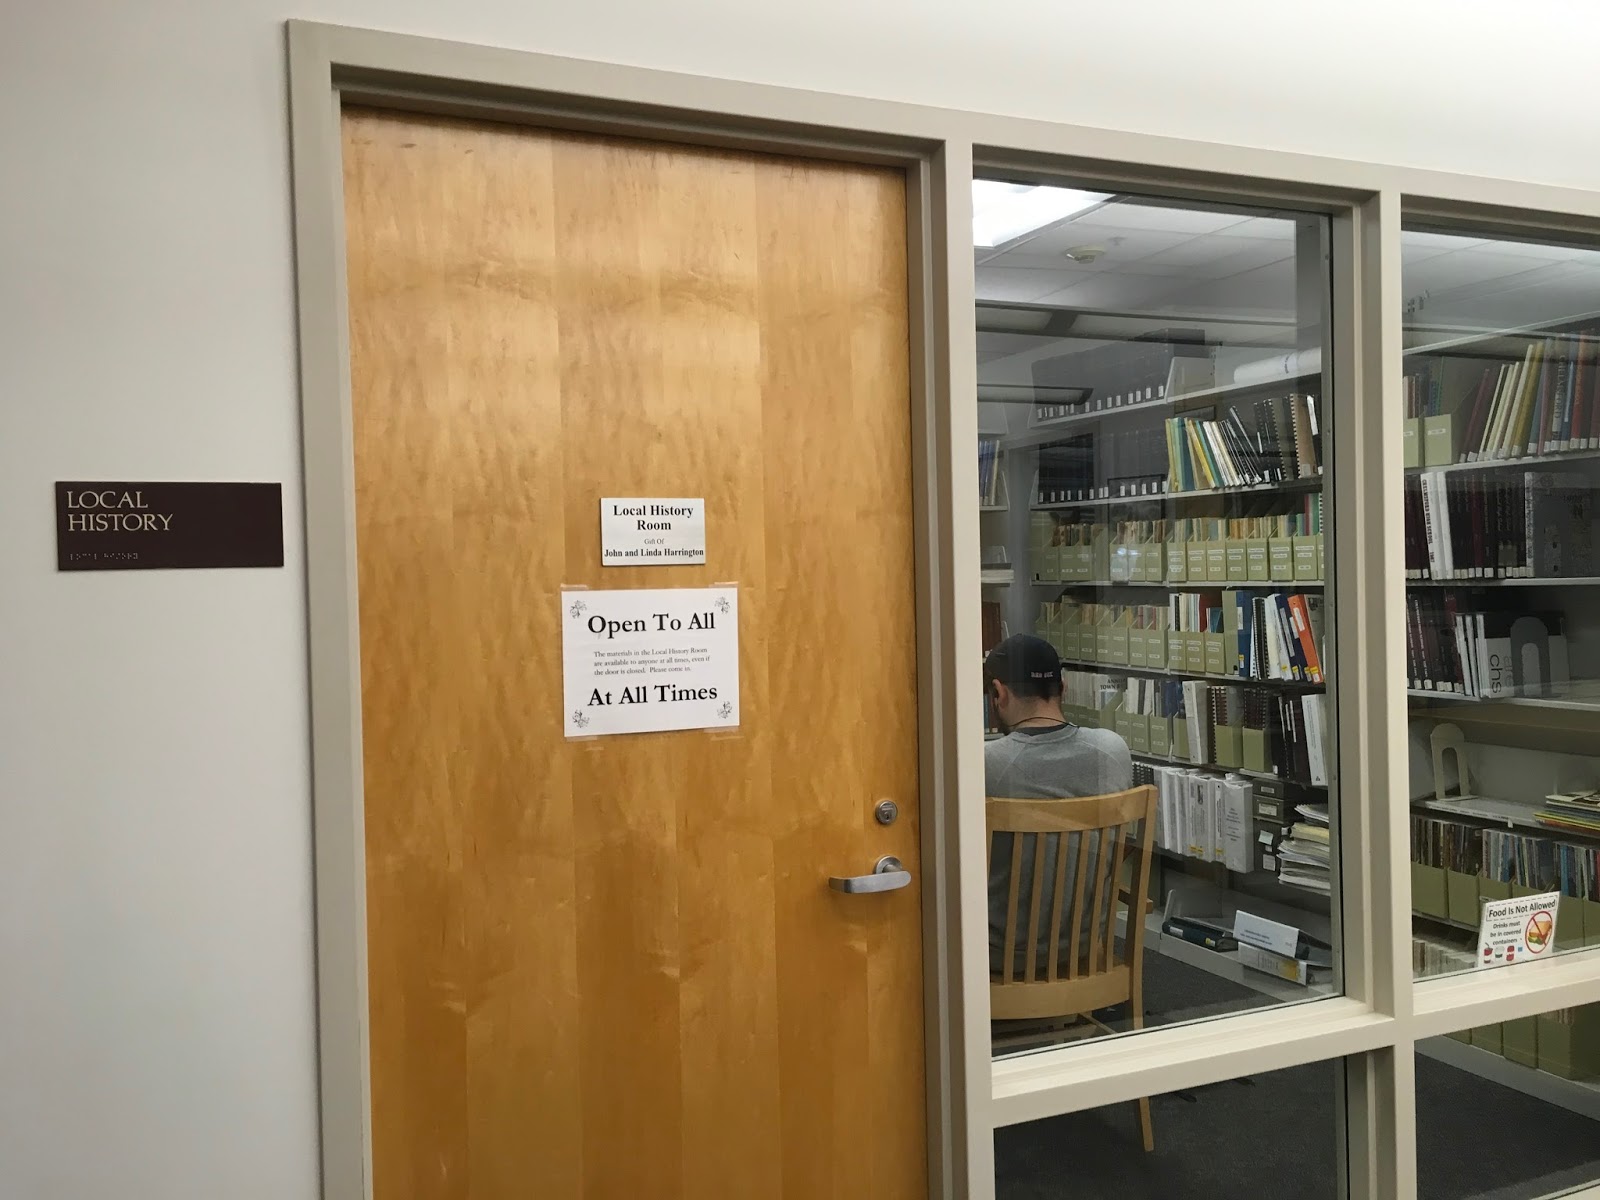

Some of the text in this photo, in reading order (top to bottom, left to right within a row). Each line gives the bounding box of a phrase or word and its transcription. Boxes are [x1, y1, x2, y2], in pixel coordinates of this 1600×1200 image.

[67, 490, 148, 508] LOCAL
[613, 504, 694, 518] Local History
[68, 513, 174, 532] HISTORY
[637, 520, 672, 530] Room
[604, 549, 622, 557] John
[640, 548, 662, 556] Linda
[664, 548, 704, 558] Harrington
[588, 612, 716, 639] Open To All
[1490, 654, 1503, 693] chs
[587, 684, 718, 706] At All Times
[1488, 907, 1507, 918] Food
[1516, 906, 1528, 914] Not
[1530, 899, 1556, 911] Allowed
